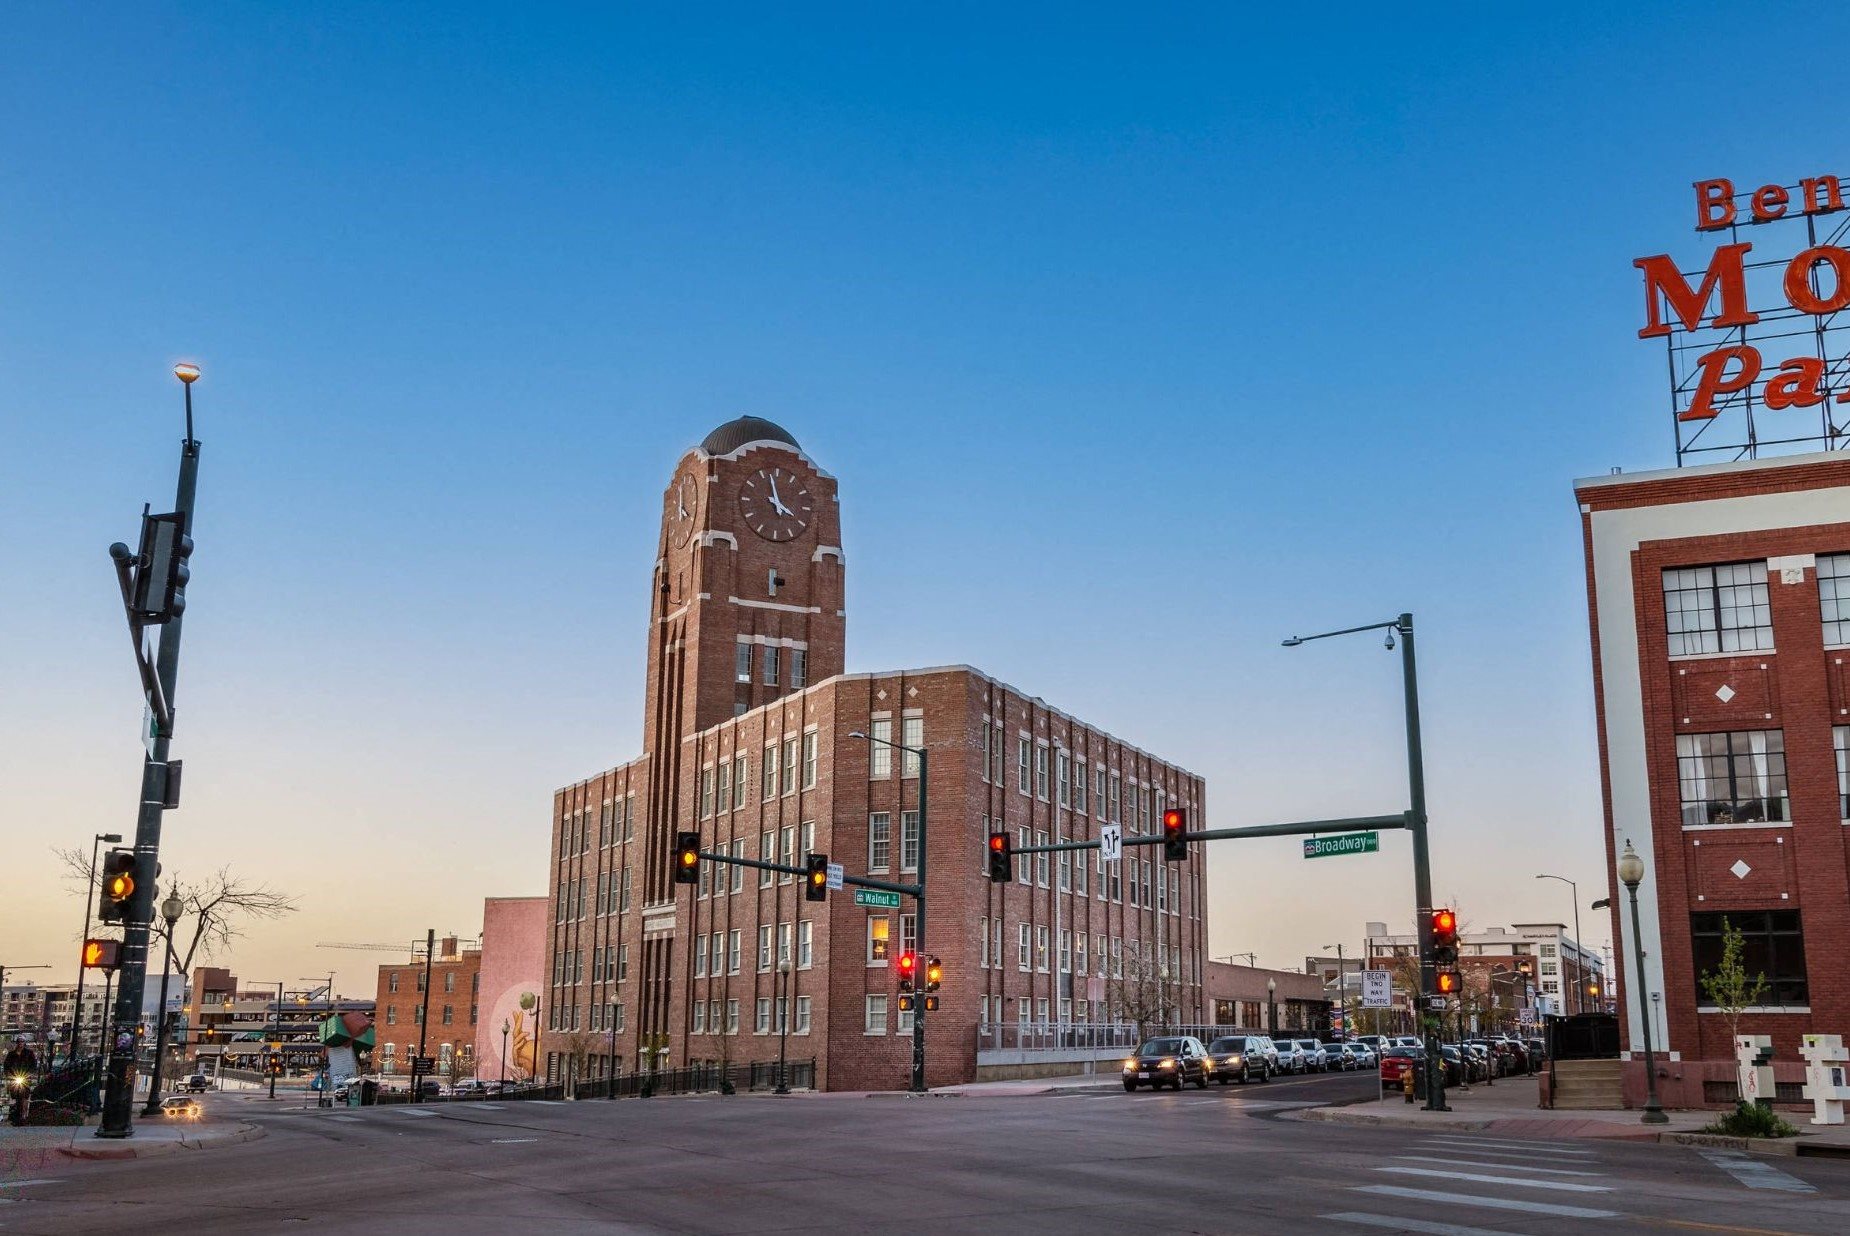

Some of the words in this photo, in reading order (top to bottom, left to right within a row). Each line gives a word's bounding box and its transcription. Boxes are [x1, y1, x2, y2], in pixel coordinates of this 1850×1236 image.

[1693, 175, 1844, 231] Ben
[1315, 836, 1367, 853] Broadway
[865, 893, 889, 905] Walnut
[1366, 972, 1386, 980] BEGIN
